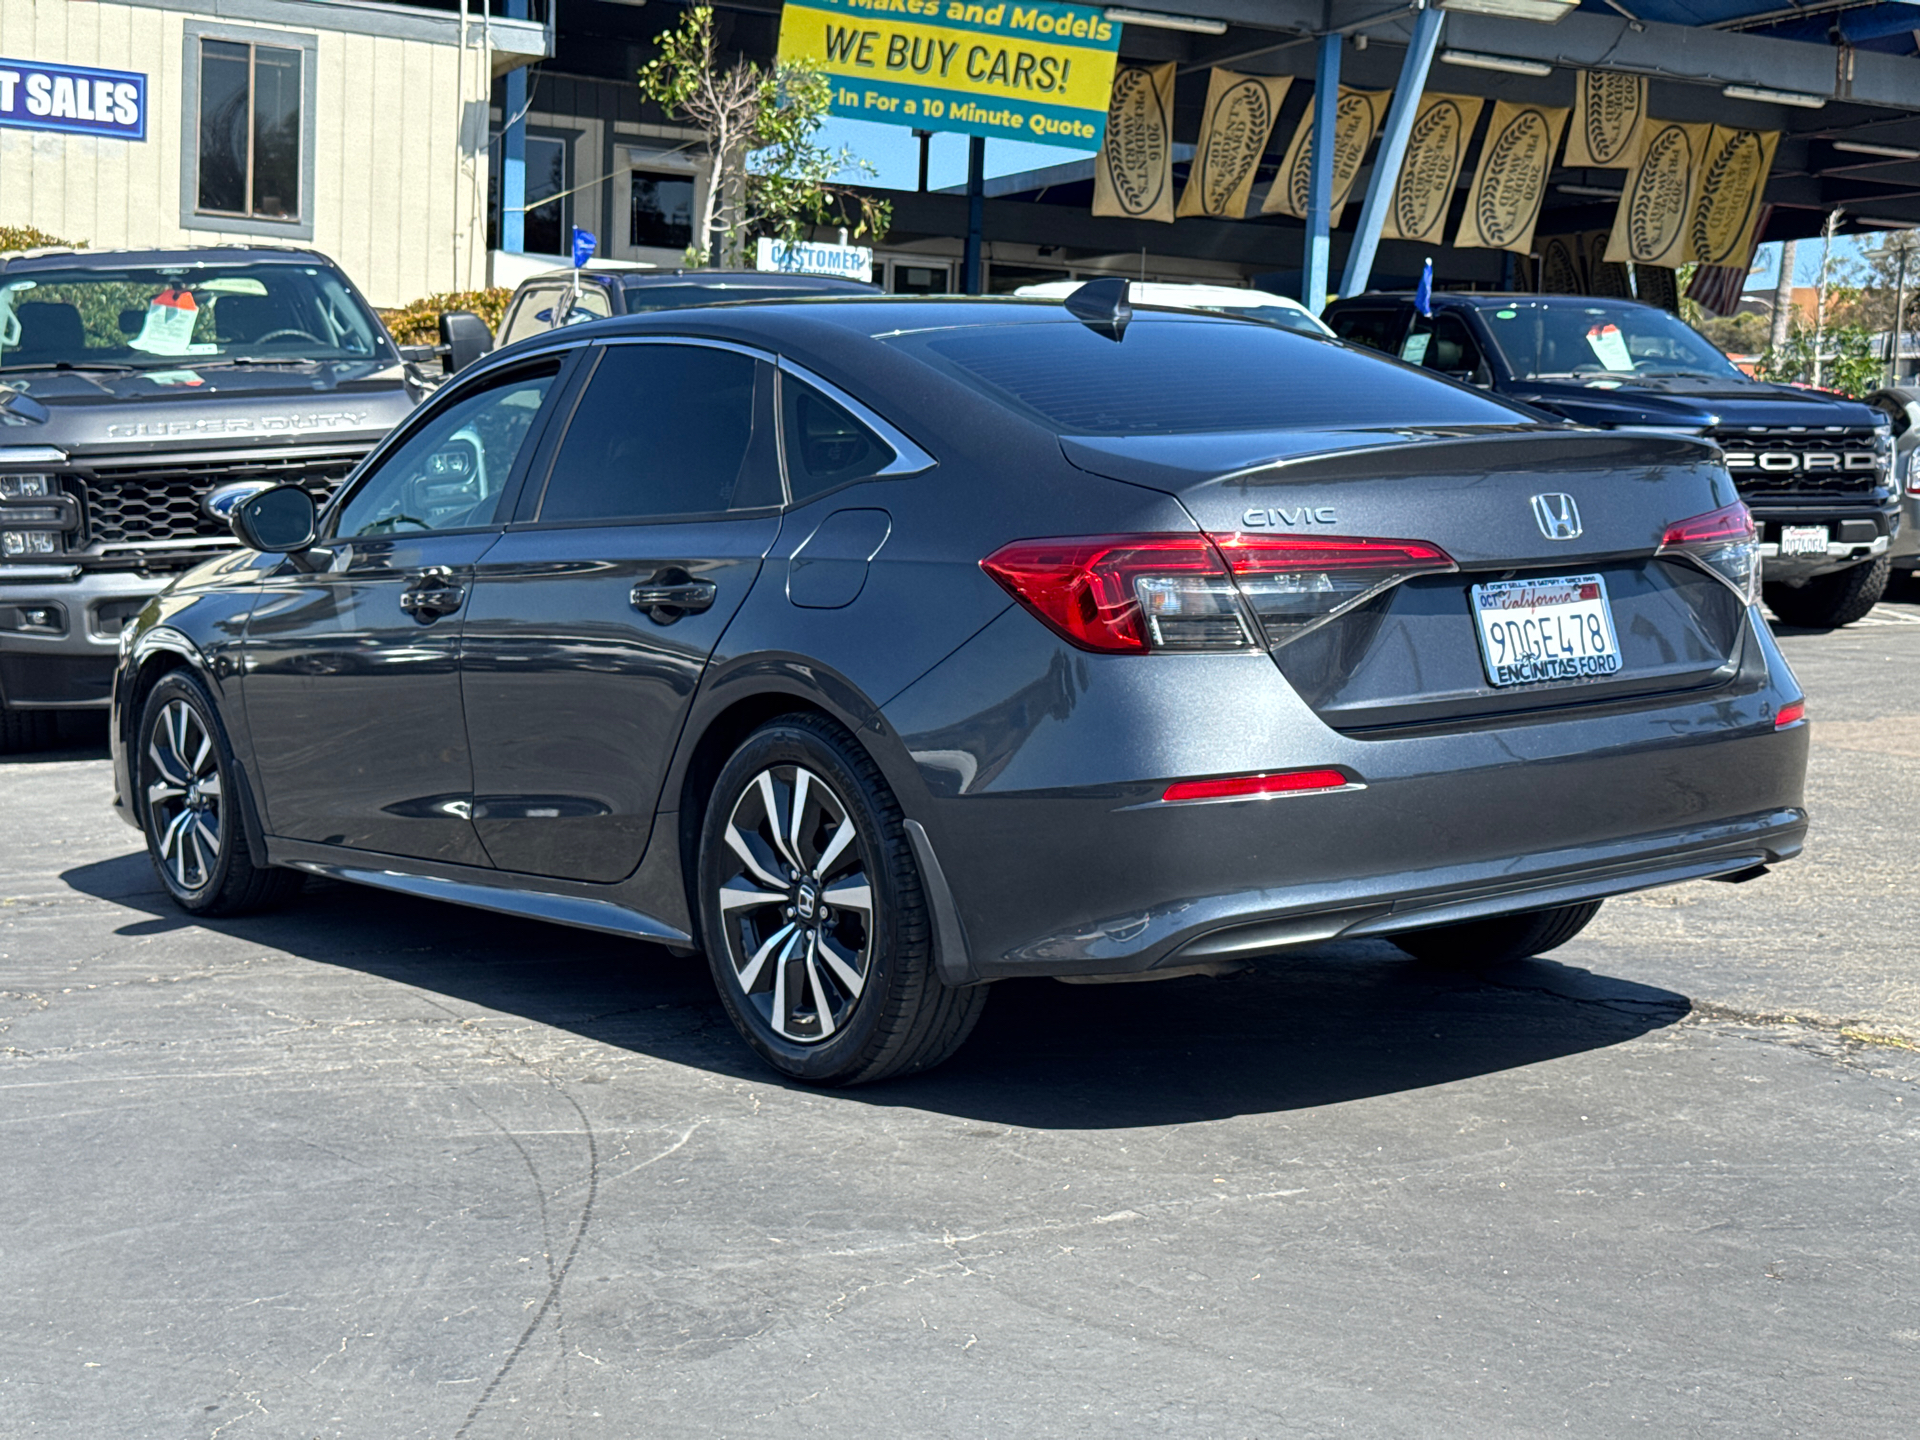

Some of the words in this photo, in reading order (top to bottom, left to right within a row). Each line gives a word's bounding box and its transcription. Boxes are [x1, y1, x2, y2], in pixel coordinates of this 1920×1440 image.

[946, 2, 1006, 26] and
[1010, 7, 1112, 41] Models
[826, 24, 881, 67] WE
[886, 34, 960, 77] BUY
[966, 45, 1071, 94] CARS!
[0, 70, 20, 112] T
[25, 73, 138, 125] SALES
[838, 87, 860, 107] In
[864, 91, 900, 112] For
[904, 100, 917, 115] a
[923, 98, 945, 117] 10
[949, 102, 1024, 128] Minute
[1029, 114, 1096, 138] Quote
[1605, 73, 1616, 122] WARD
[1624, 76, 1635, 110] 2021
[1124, 112, 1136, 171] AWARD
[1134, 89, 1148, 195] PRESIDENT'S
[1147, 123, 1162, 162] 2016
[1210, 130, 1224, 168] 2017
[1226, 121, 1246, 177] AWARD
[1339, 144, 1362, 180] 2018
[1414, 144, 1434, 200] AWARD
[1433, 154, 1452, 190] 2019
[1499, 153, 1523, 207] AWARD
[1522, 164, 1542, 201] 2020
[1667, 179, 1683, 215] 2022
[1710, 167, 1736, 229] AWARD
[107, 417, 255, 438] SUPER
[261, 412, 367, 431] DUTY
[1725, 452, 1877, 470] FORD
[1242, 507, 1338, 527] CIVIC
[1480, 594, 1498, 607] OCT
[1502, 588, 1571, 614] California
[1490, 613, 1606, 664] 9DGE478
[1497, 658, 1578, 683] ENCINITAS
[1579, 654, 1617, 674] FORD
